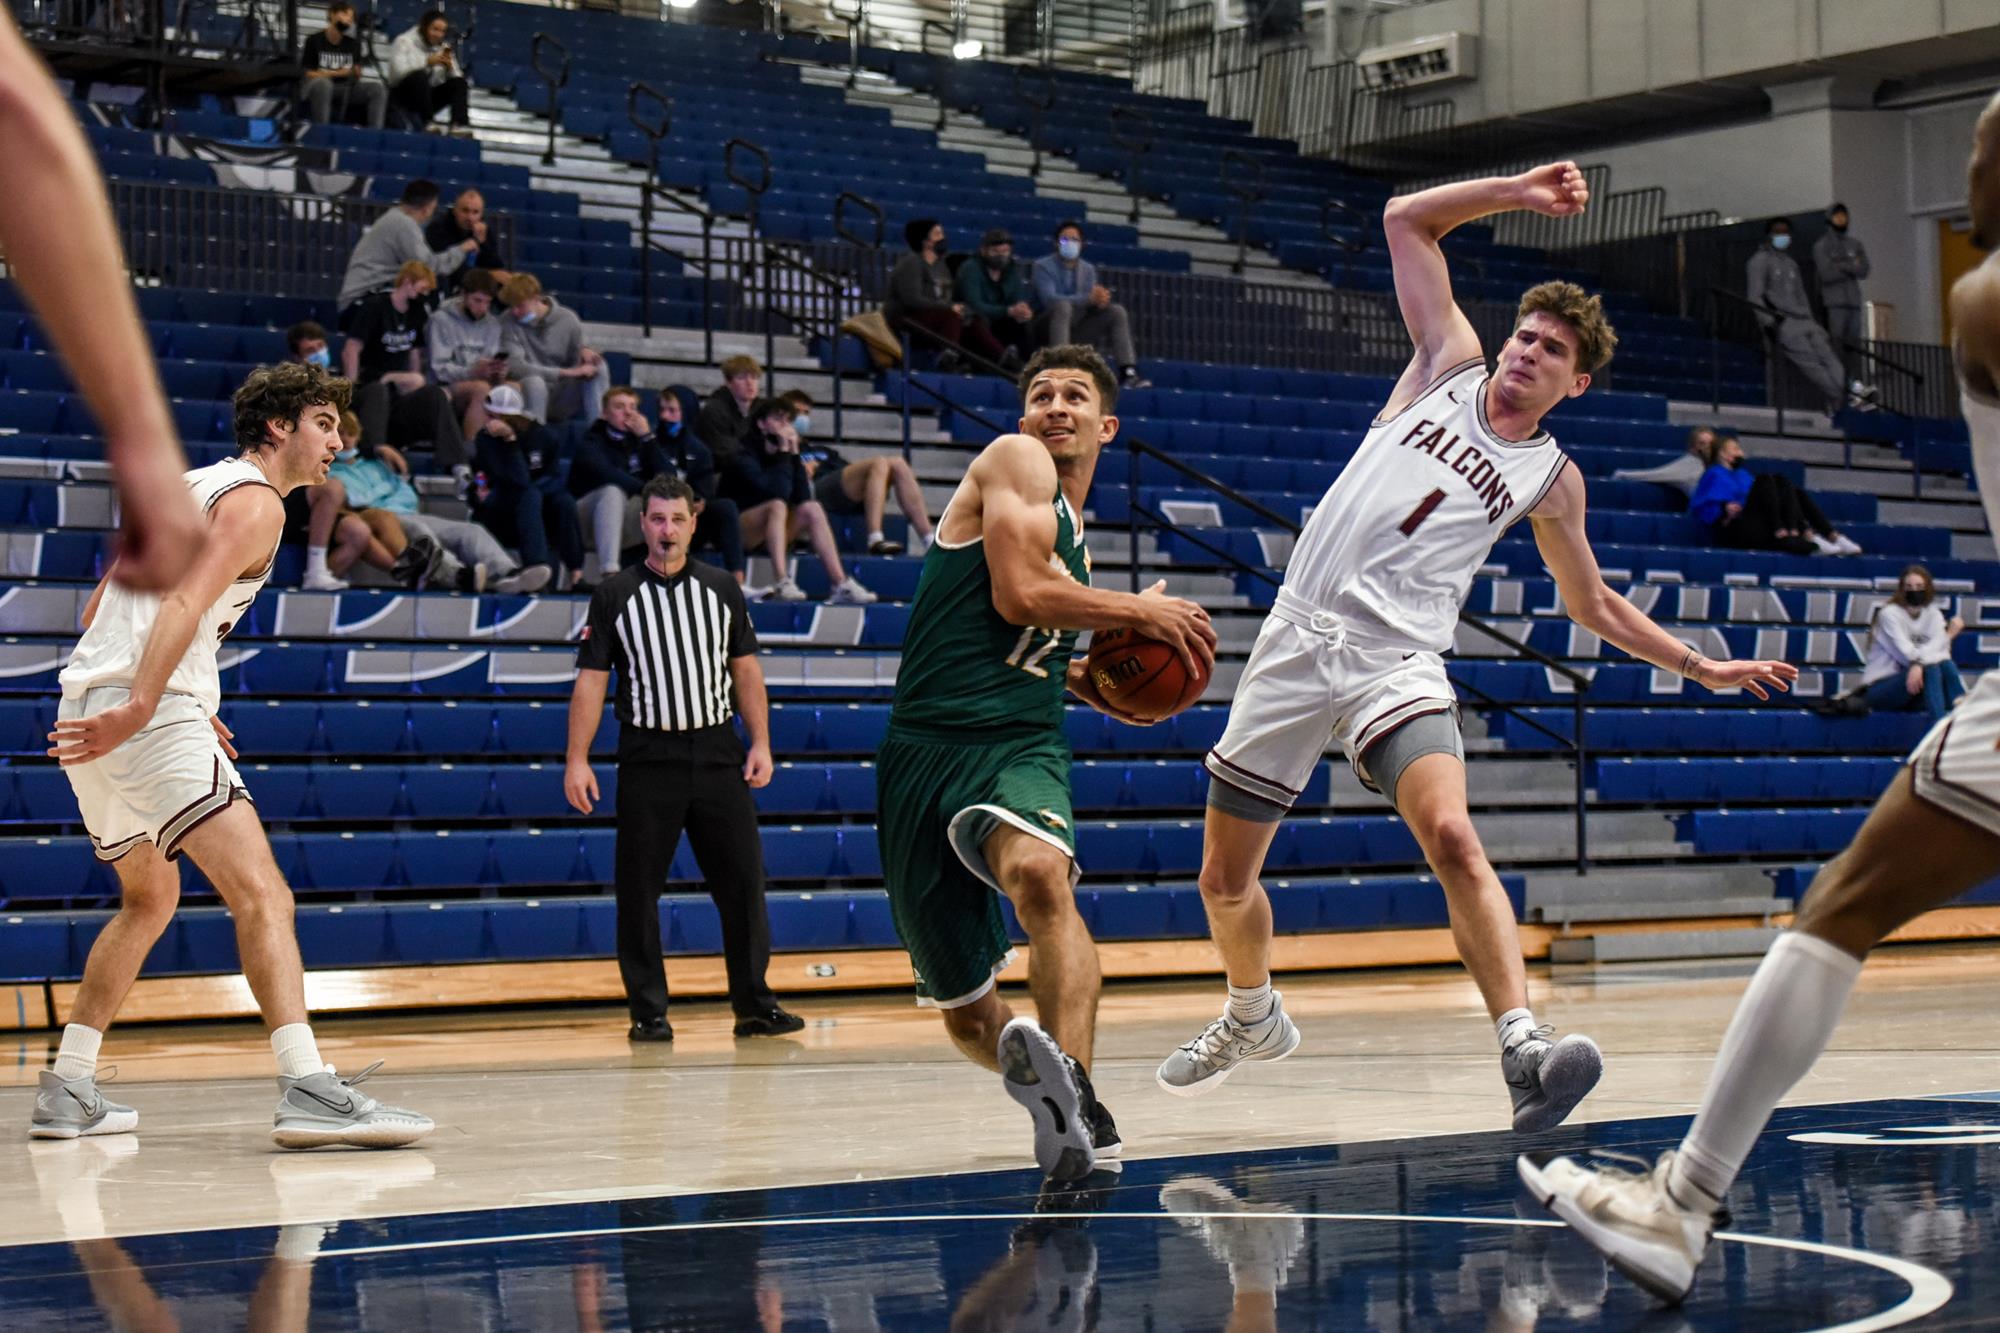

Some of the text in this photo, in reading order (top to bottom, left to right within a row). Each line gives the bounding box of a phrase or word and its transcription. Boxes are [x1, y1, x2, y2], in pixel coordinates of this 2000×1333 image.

[1399, 418, 1514, 525] FALCONS
[1399, 487, 1449, 539] 1
[1004, 626, 1061, 678] 12
